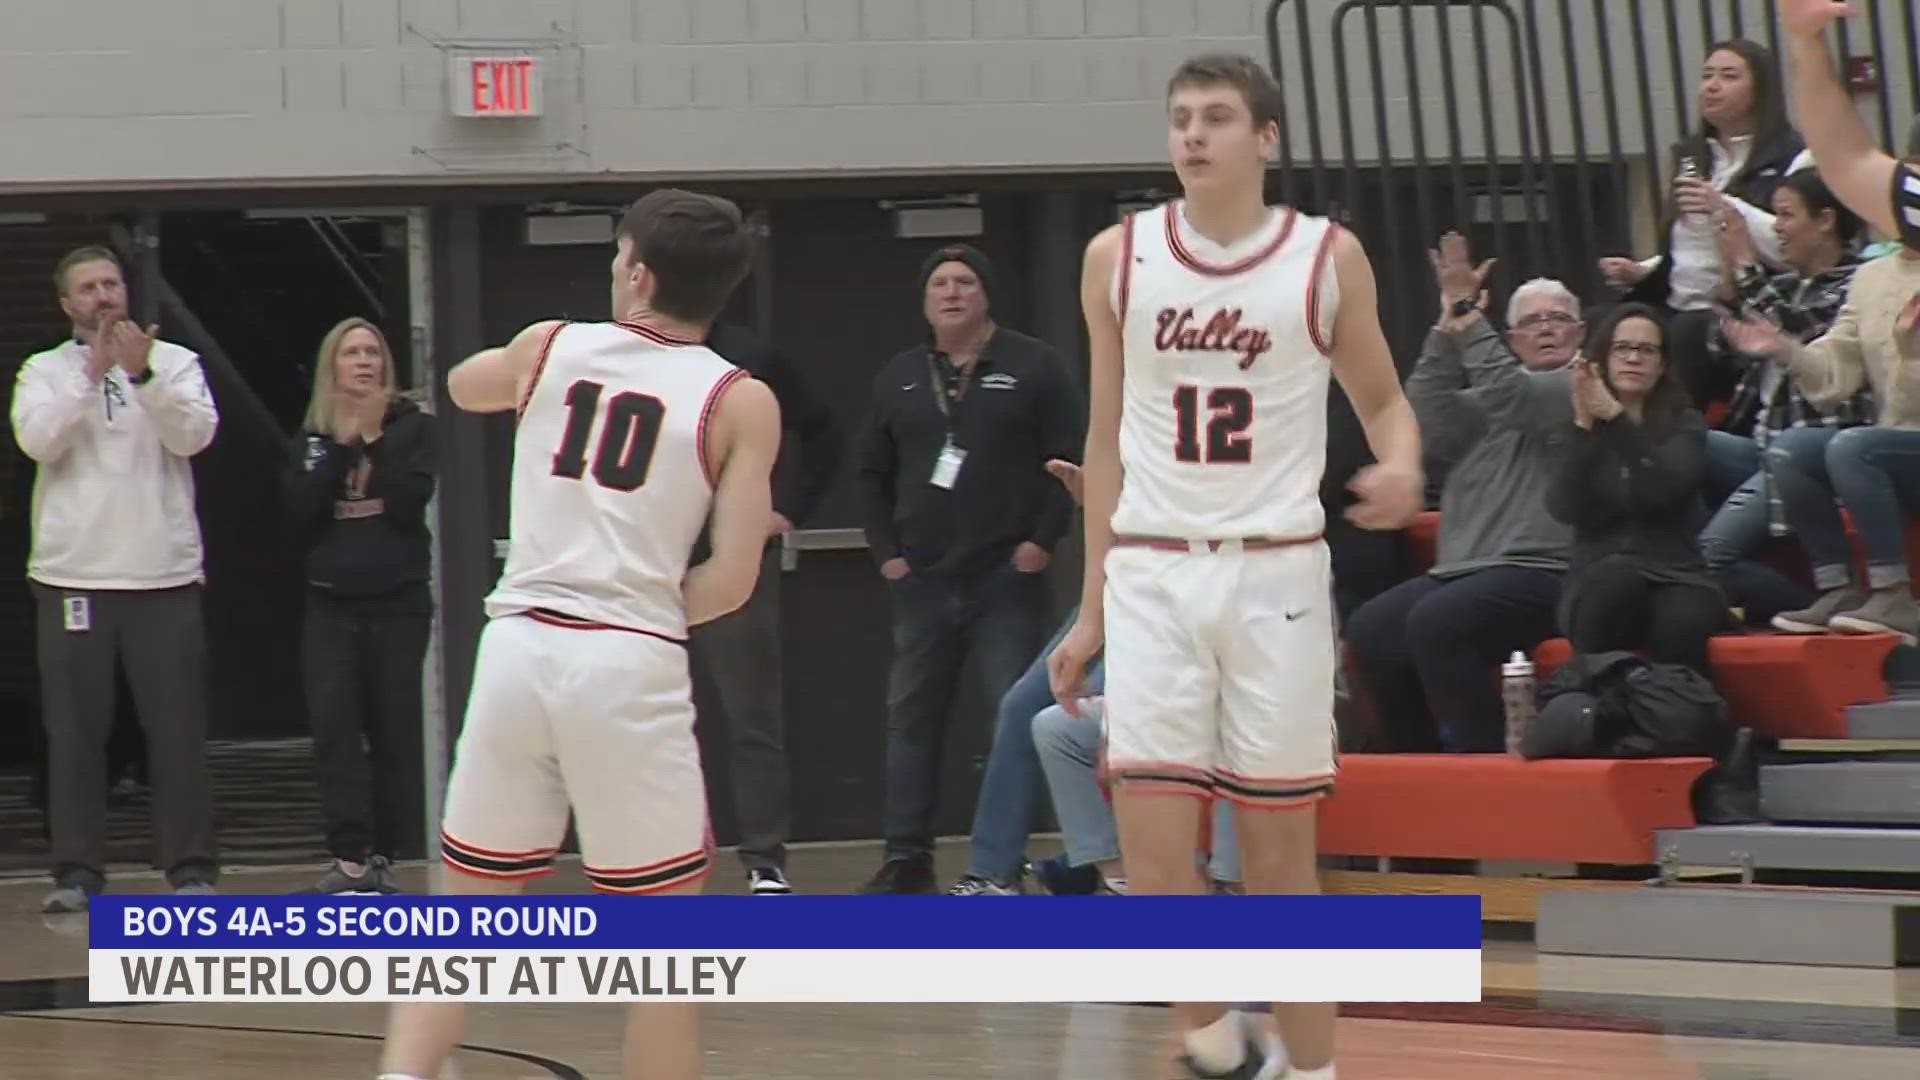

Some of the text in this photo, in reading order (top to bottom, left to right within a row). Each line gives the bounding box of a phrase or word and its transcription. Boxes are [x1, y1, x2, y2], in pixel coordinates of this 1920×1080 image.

[471, 60, 531, 111] EXIT
[1155, 307, 1272, 370] Valley
[551, 379, 666, 492] 10
[1173, 385, 1253, 464] 12
